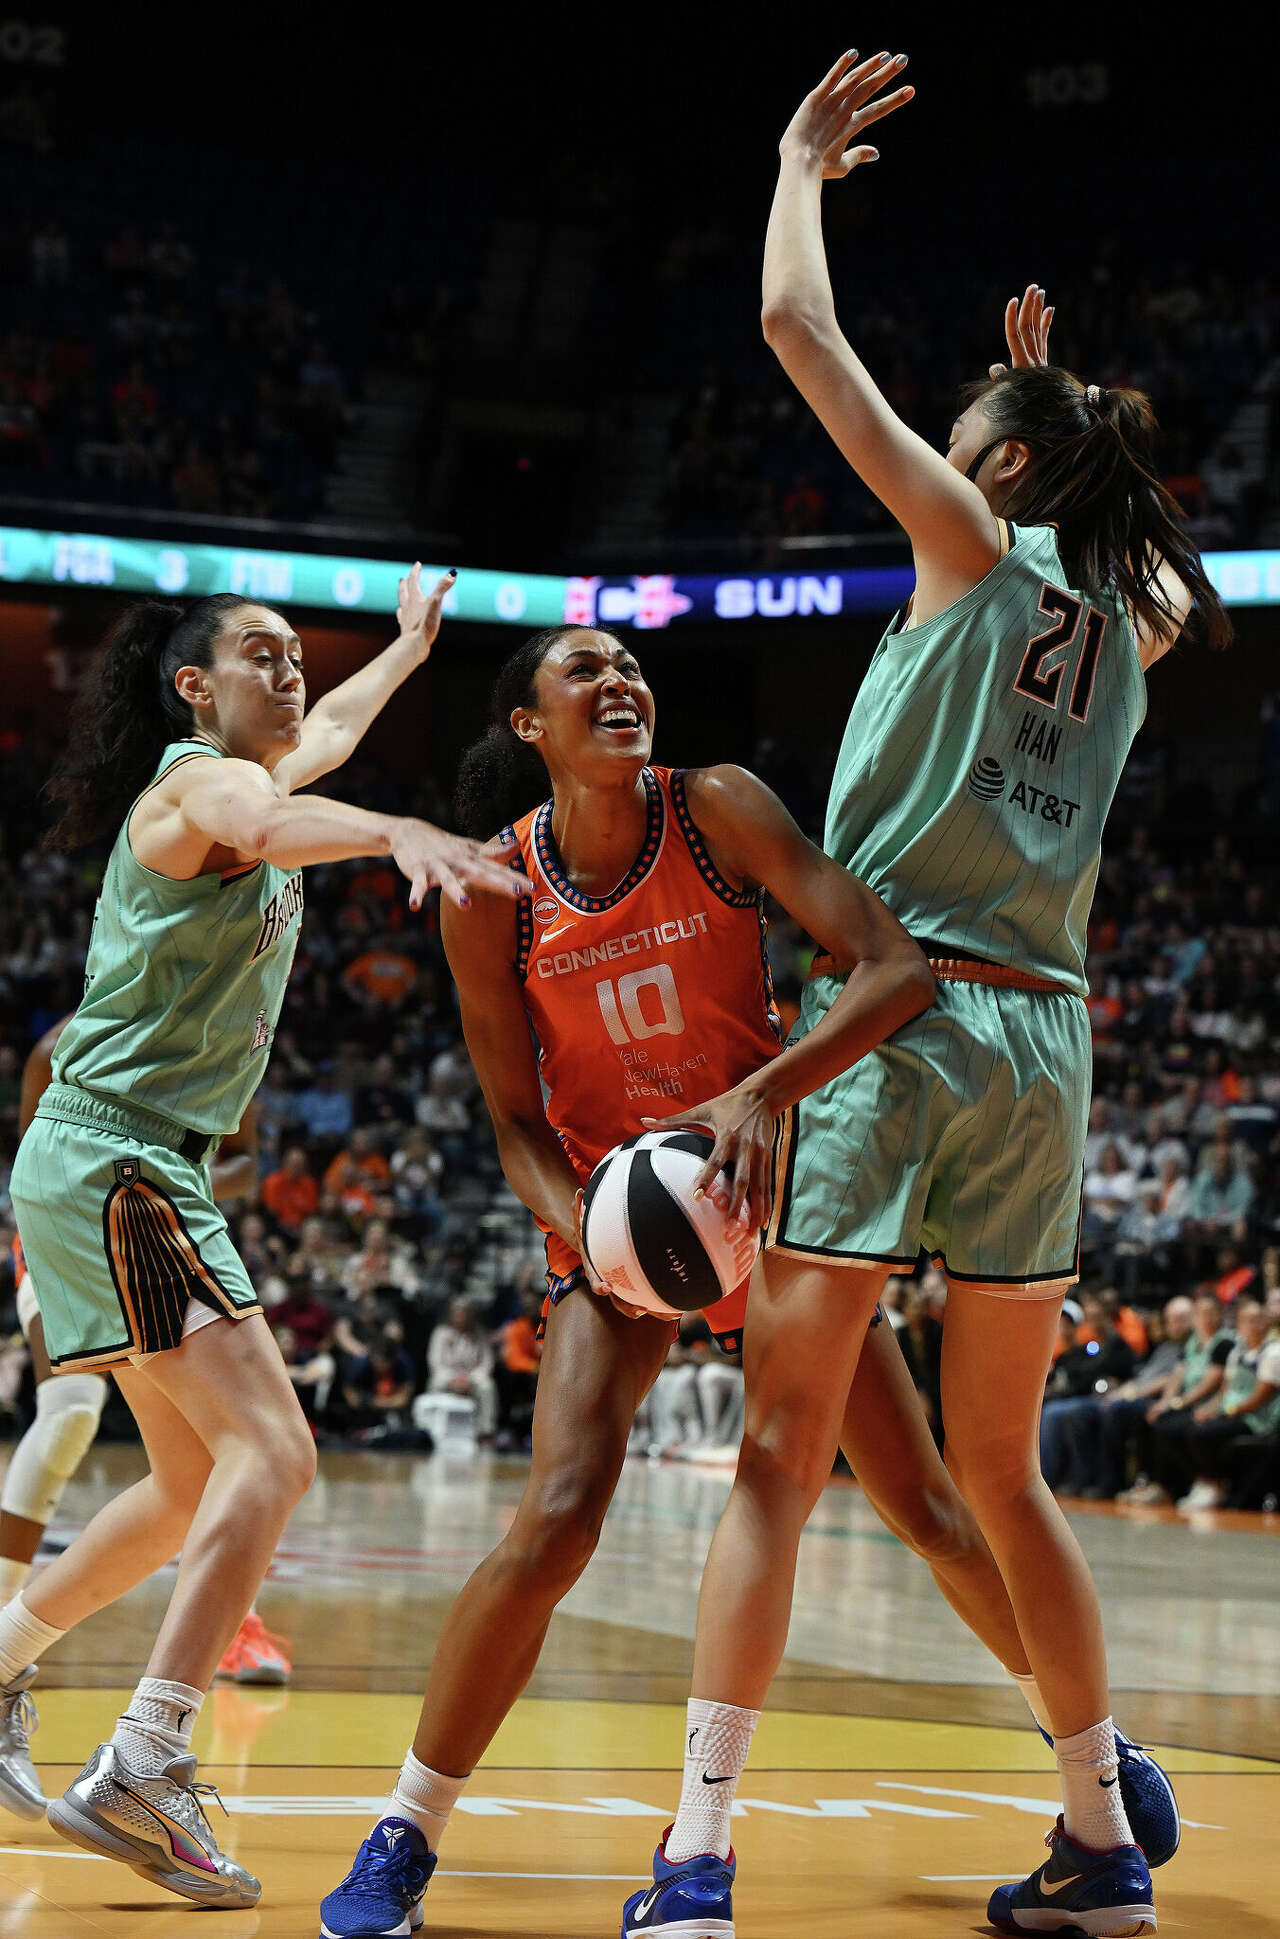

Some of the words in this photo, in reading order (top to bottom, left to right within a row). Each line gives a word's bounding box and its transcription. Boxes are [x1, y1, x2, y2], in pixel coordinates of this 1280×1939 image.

[156, 550, 188, 592] 3
[333, 567, 364, 606] 0
[495, 580, 527, 620] 0
[714, 575, 842, 618] SUN
[1013, 581, 1108, 724] 21
[1014, 710, 1063, 766] HAN
[1008, 780, 1080, 828] AT&T
[536, 912, 708, 979] CONNECTICUT
[596, 963, 685, 1045] 10
[625, 1079, 684, 1100] Health
